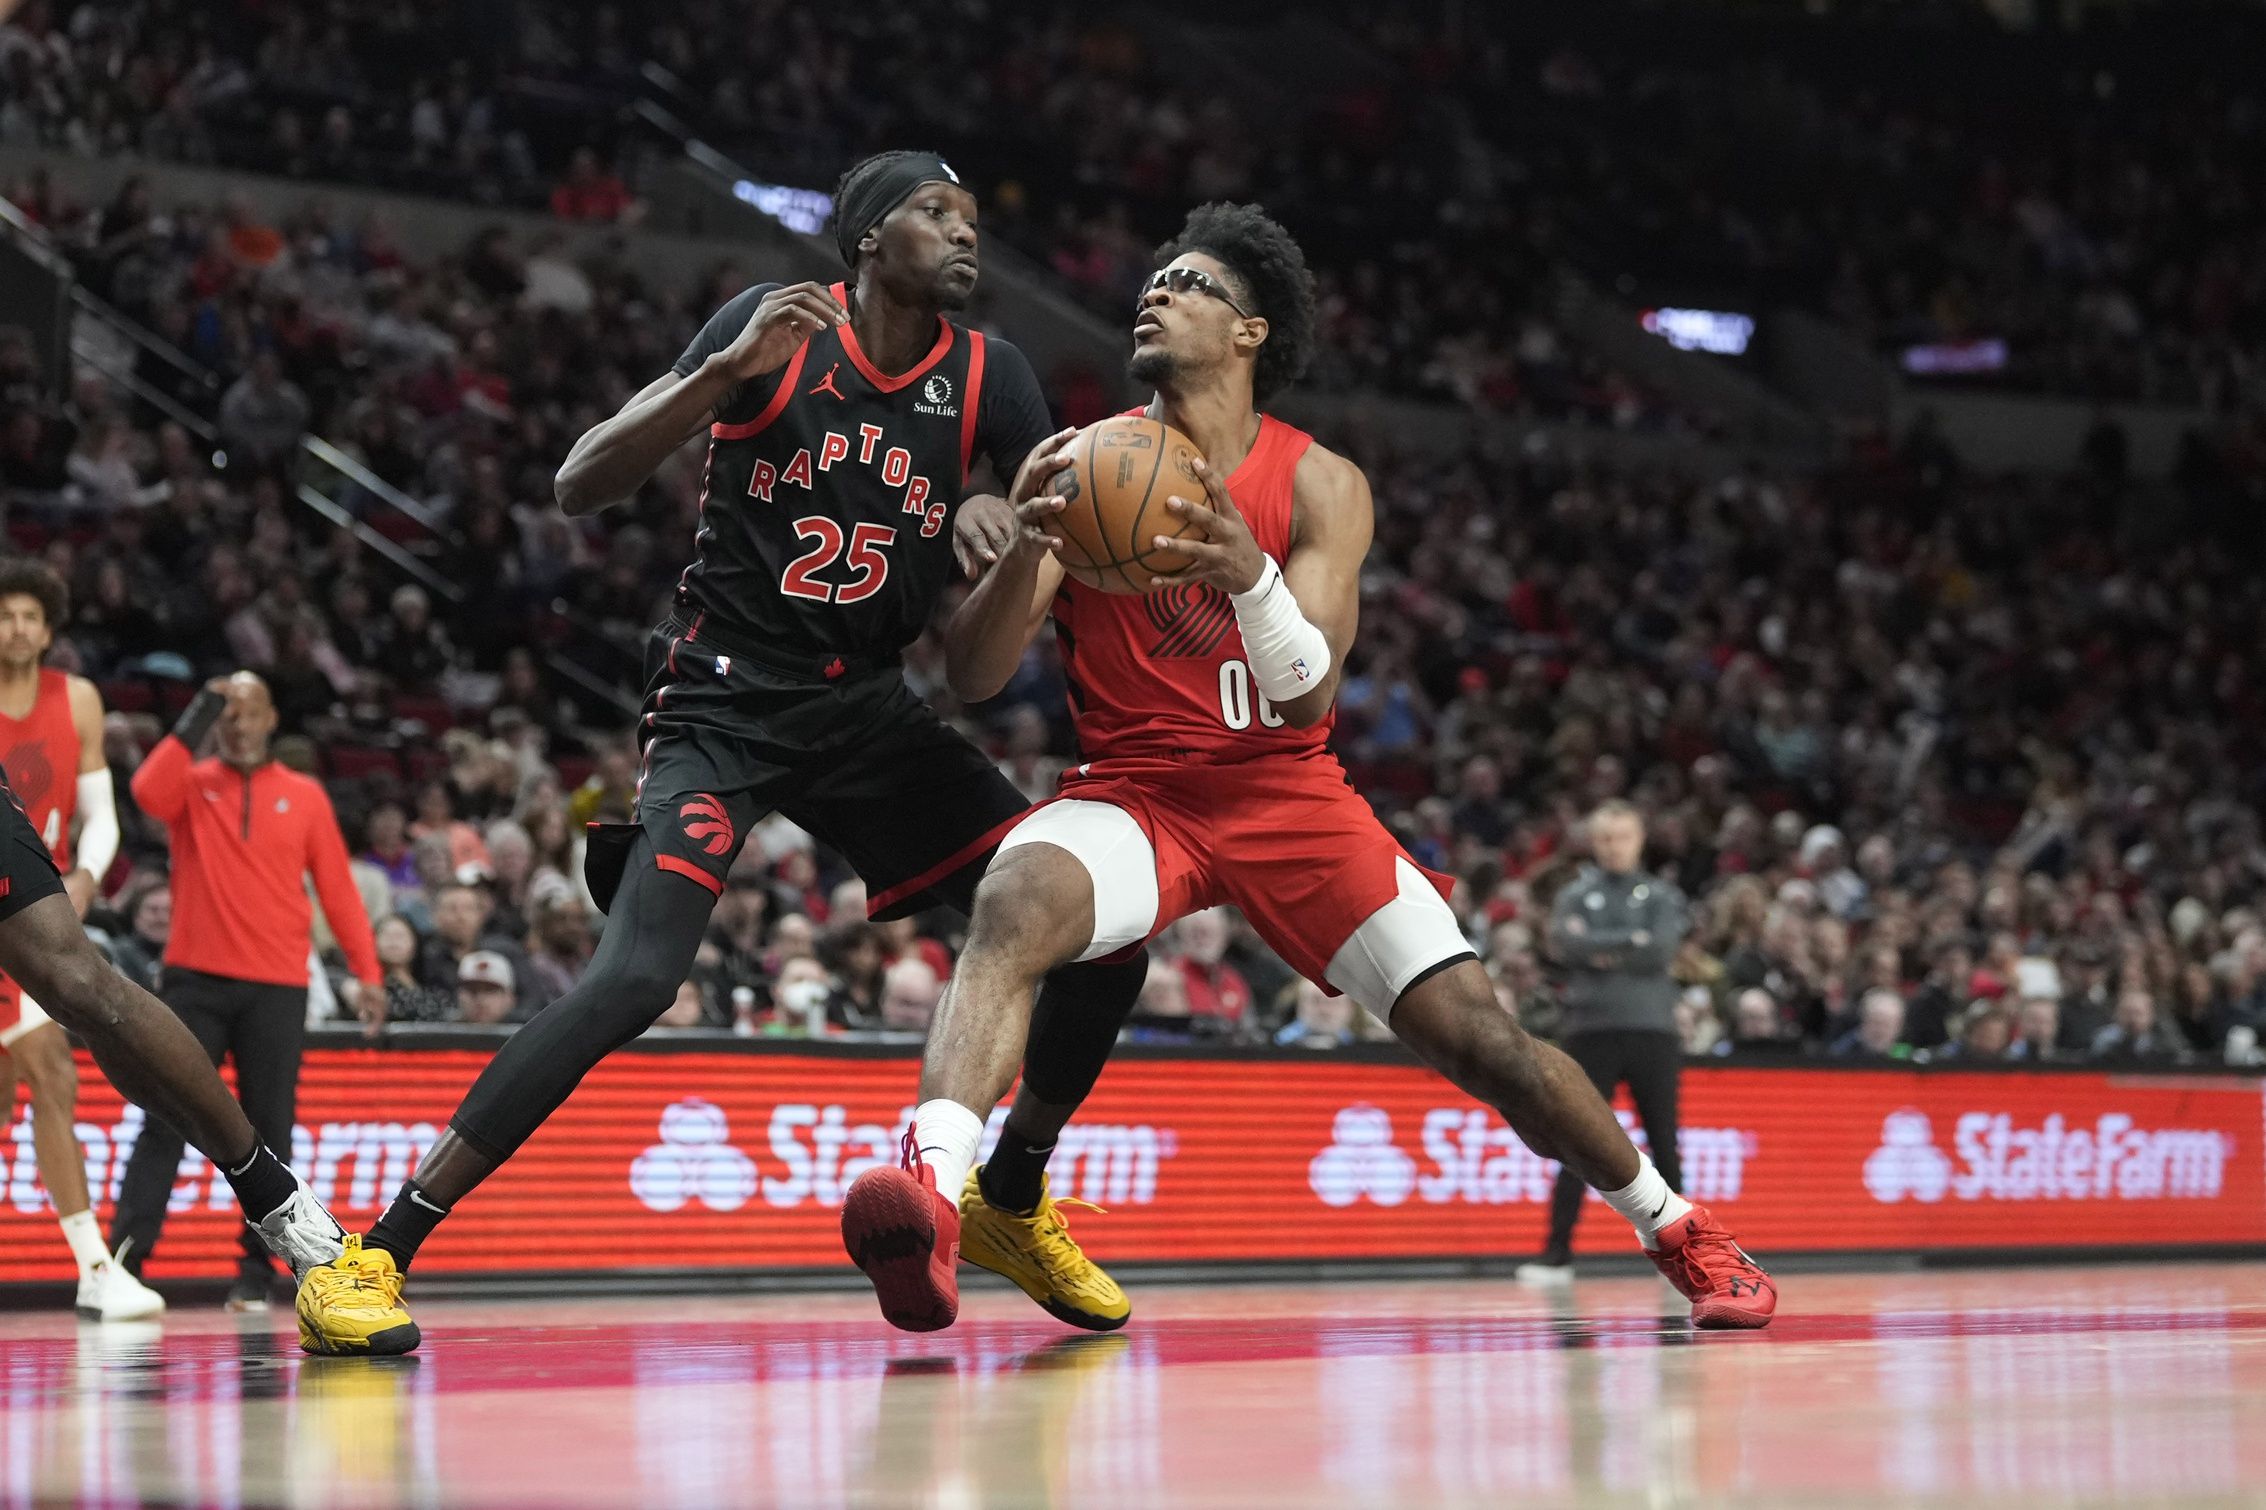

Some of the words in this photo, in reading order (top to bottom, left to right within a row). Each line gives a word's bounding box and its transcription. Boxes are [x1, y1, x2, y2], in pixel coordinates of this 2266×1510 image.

[913, 402, 935, 414] Sun
[936, 405, 958, 417] Life
[748, 422, 946, 538] RAPTORS
[780, 514, 898, 604] 25
[42, 808, 61, 851] 4
